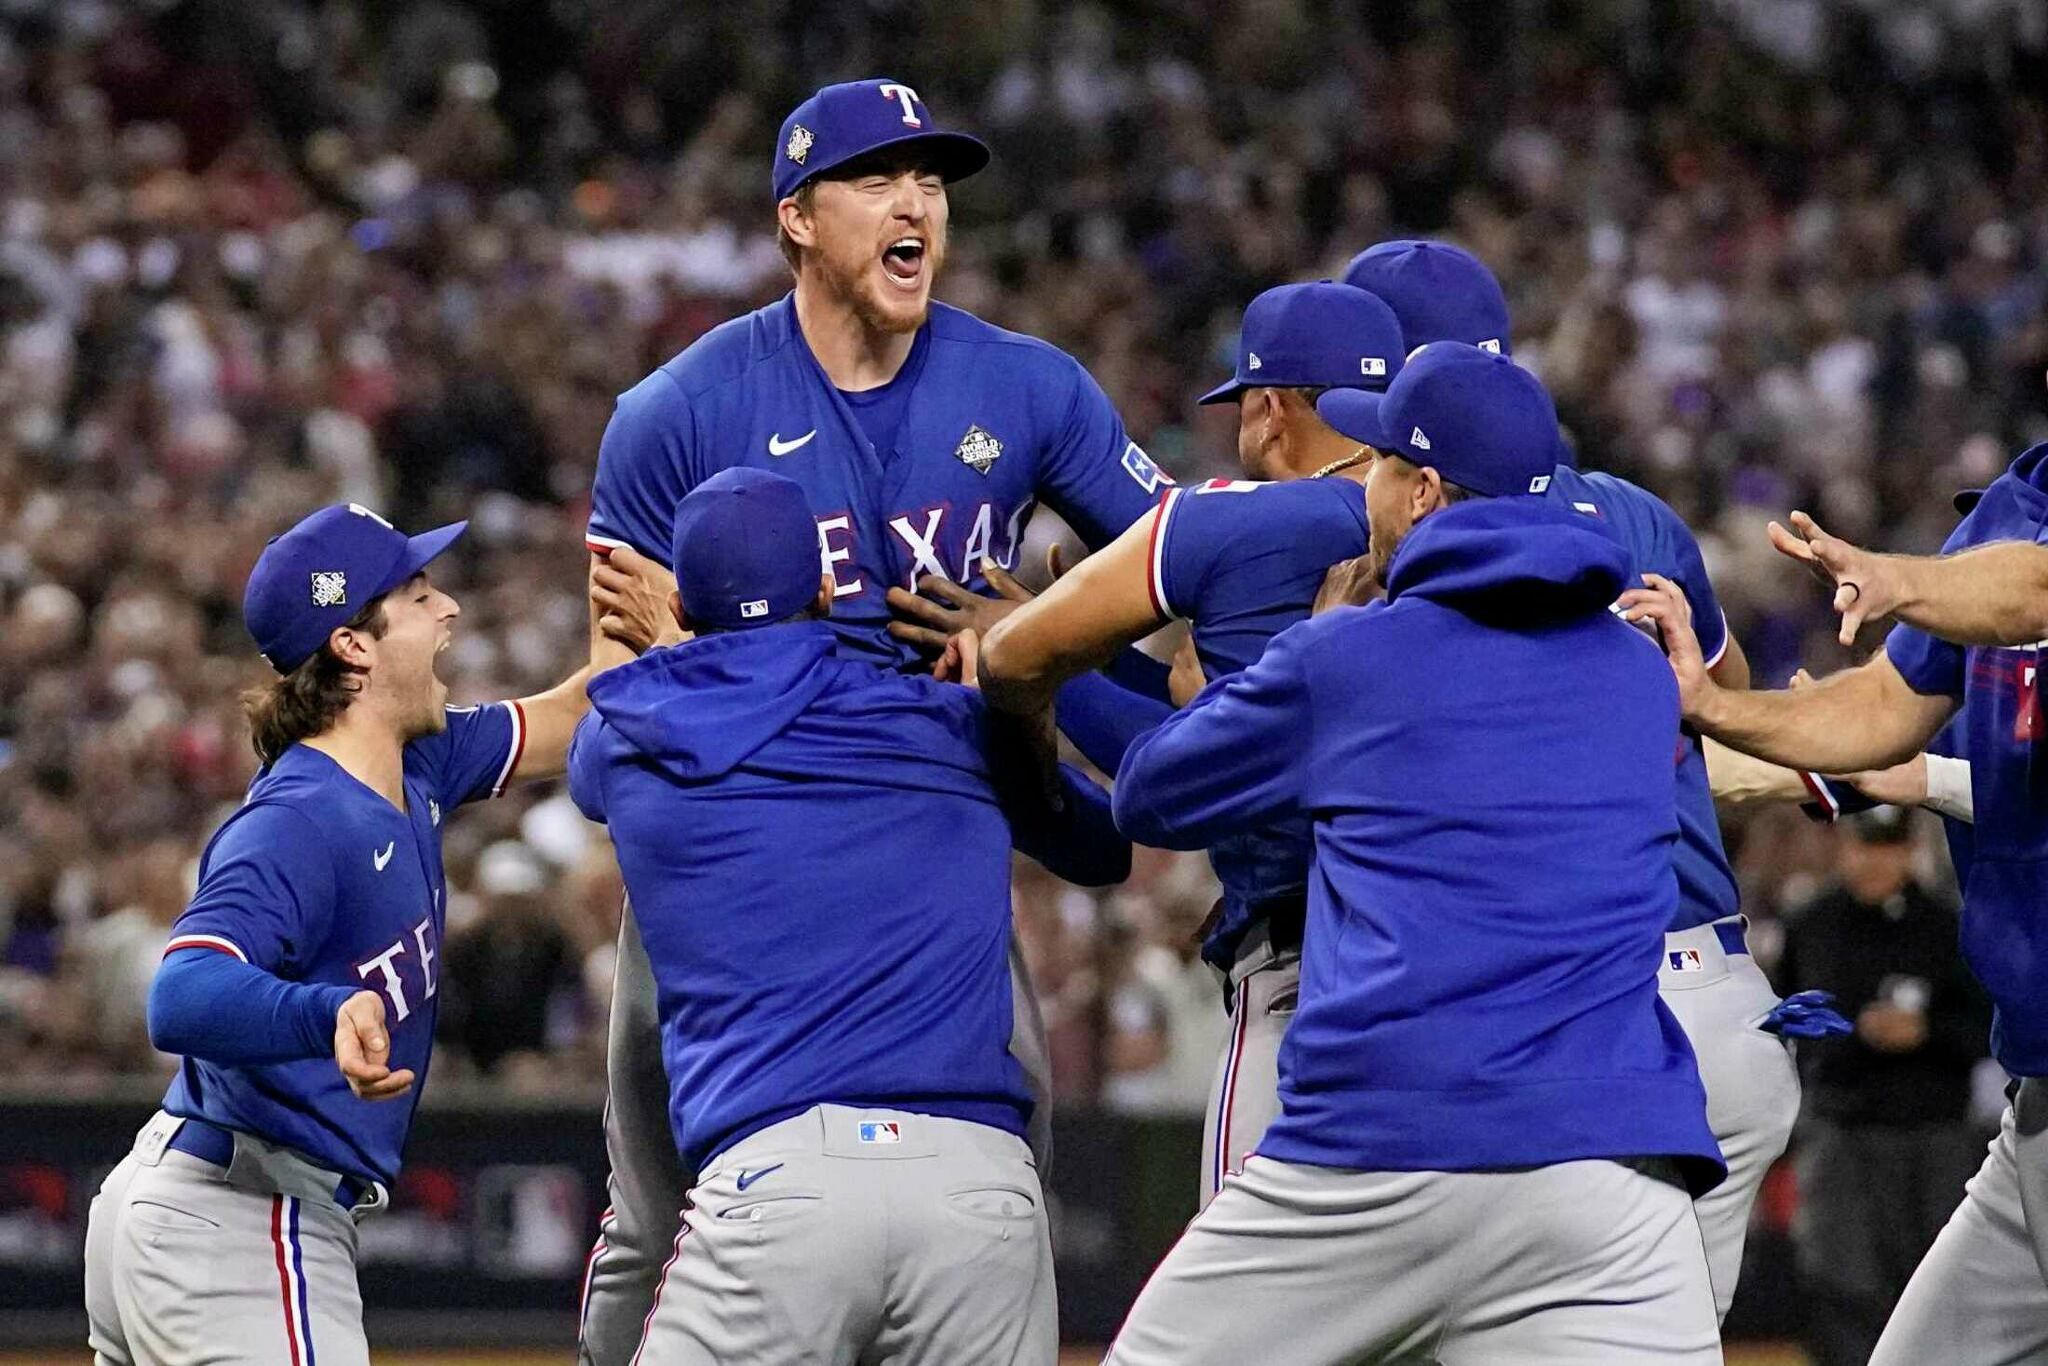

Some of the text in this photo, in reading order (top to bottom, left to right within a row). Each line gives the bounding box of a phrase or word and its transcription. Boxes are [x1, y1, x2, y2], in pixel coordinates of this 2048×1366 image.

[879, 83, 922, 129] T
[959, 438, 998, 456] WORLD
[962, 450, 1000, 463] SERIES
[815, 493, 1034, 597] EXAS
[357, 914, 437, 1022] TE
